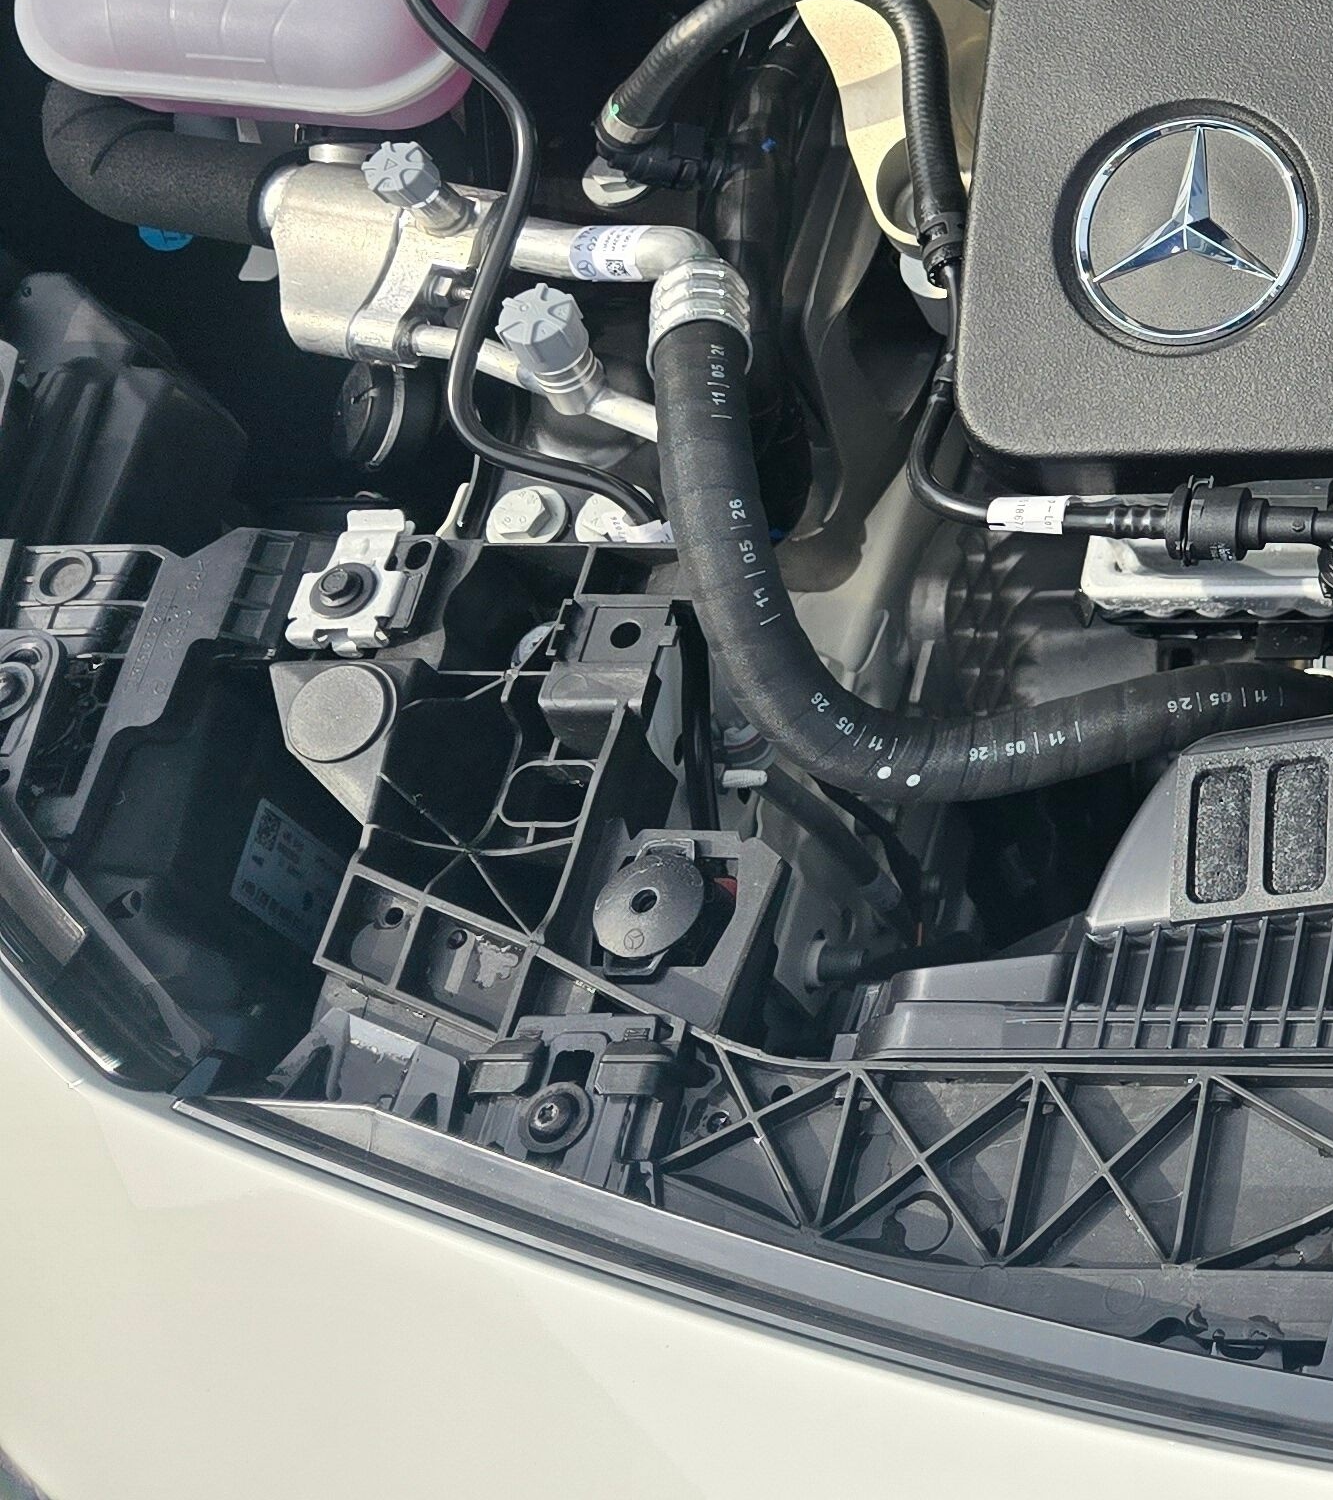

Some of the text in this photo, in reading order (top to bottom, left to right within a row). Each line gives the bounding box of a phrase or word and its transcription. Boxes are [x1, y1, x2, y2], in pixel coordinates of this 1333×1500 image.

[710, 362, 726, 380] 05
[710, 390, 726, 406] 11
[728, 497, 770, 610] 11 05 26
[1166, 688, 1269, 715] 11 05 26
[809, 691, 884, 753] 11 05 26
[968, 731, 1067, 763] 11 05 26
